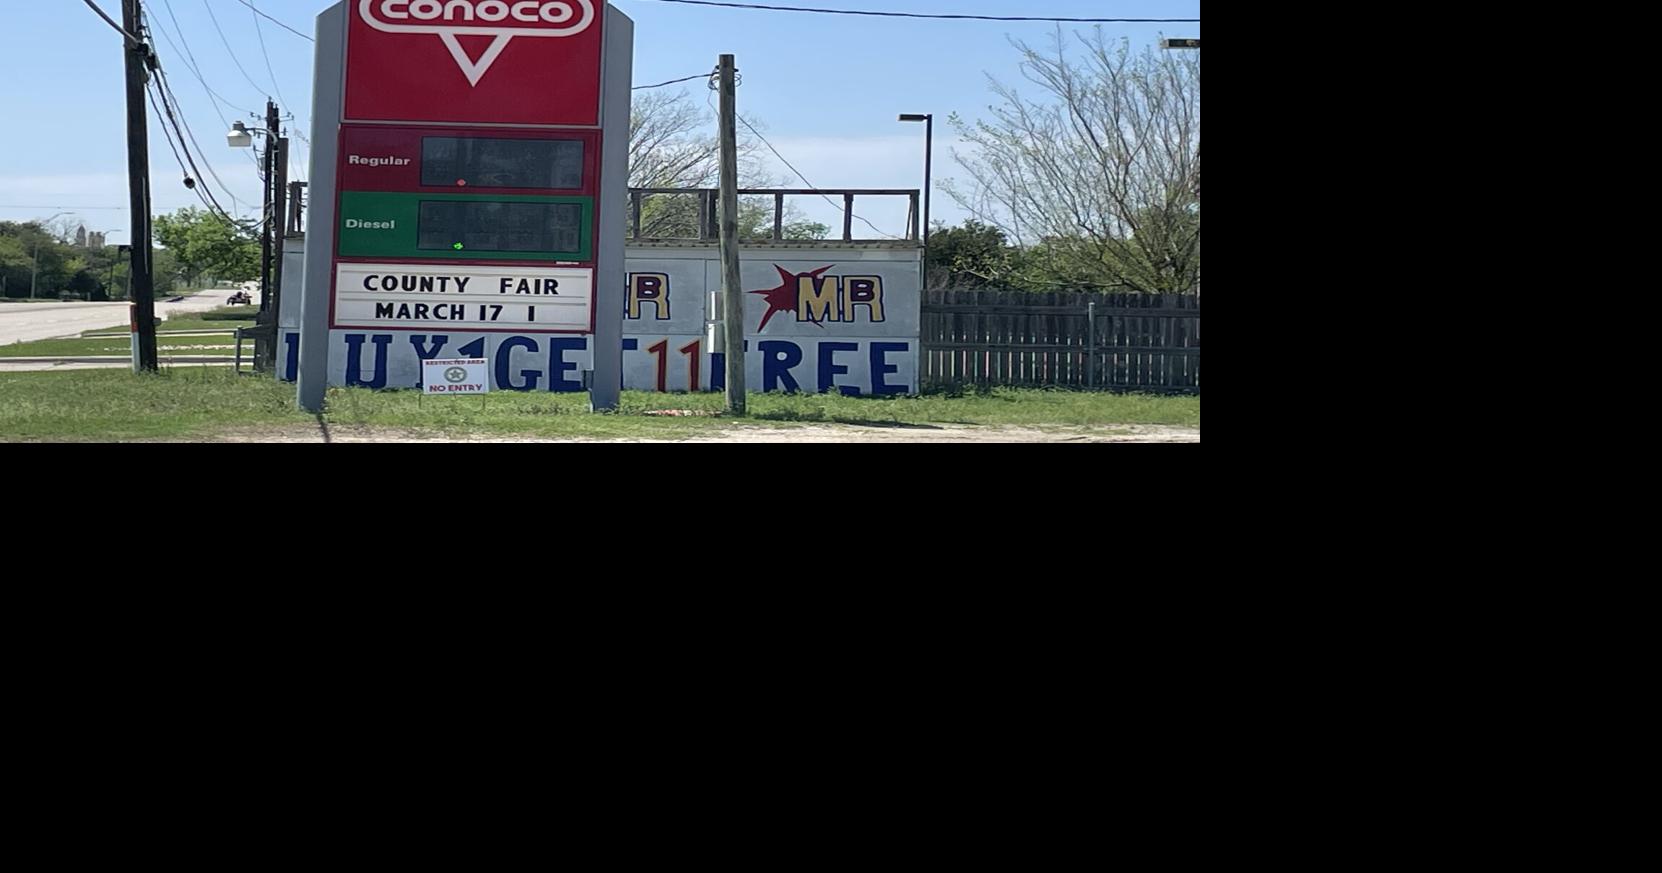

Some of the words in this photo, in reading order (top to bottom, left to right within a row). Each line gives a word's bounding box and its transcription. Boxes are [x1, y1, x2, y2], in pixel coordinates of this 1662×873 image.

[349, 155, 410, 166] Regular
[346, 219, 395, 229] Diesel
[363, 275, 470, 292] COUNTY
[500, 277, 559, 294] FAIR
[375, 303, 465, 320] MARCH
[479, 305, 503, 321] 17
[648, 339, 700, 392] 11
